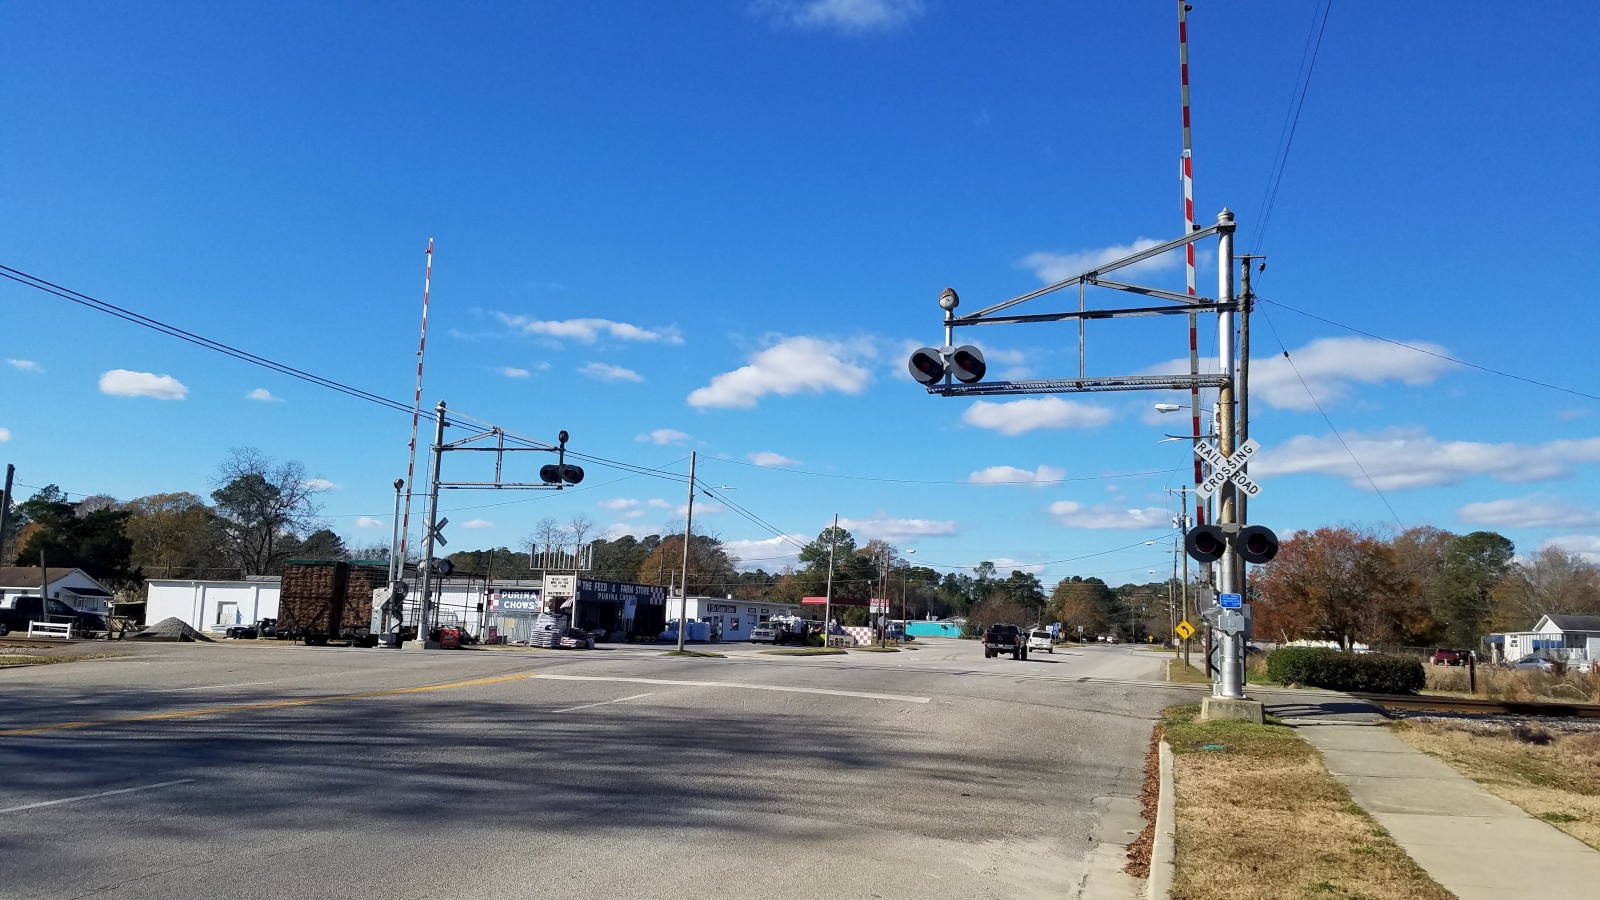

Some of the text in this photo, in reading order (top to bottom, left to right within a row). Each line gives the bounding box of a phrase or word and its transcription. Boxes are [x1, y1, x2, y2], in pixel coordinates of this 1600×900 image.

[1197, 442, 1258, 494] RAIL ROAD
[1203, 445, 1253, 492] CROSSING
[582, 581, 650, 595] THE FEED & FARM STORE
[502, 591, 537, 599] PURINA
[598, 592, 618, 600] PURINA
[504, 601, 535, 609] CHOWS
